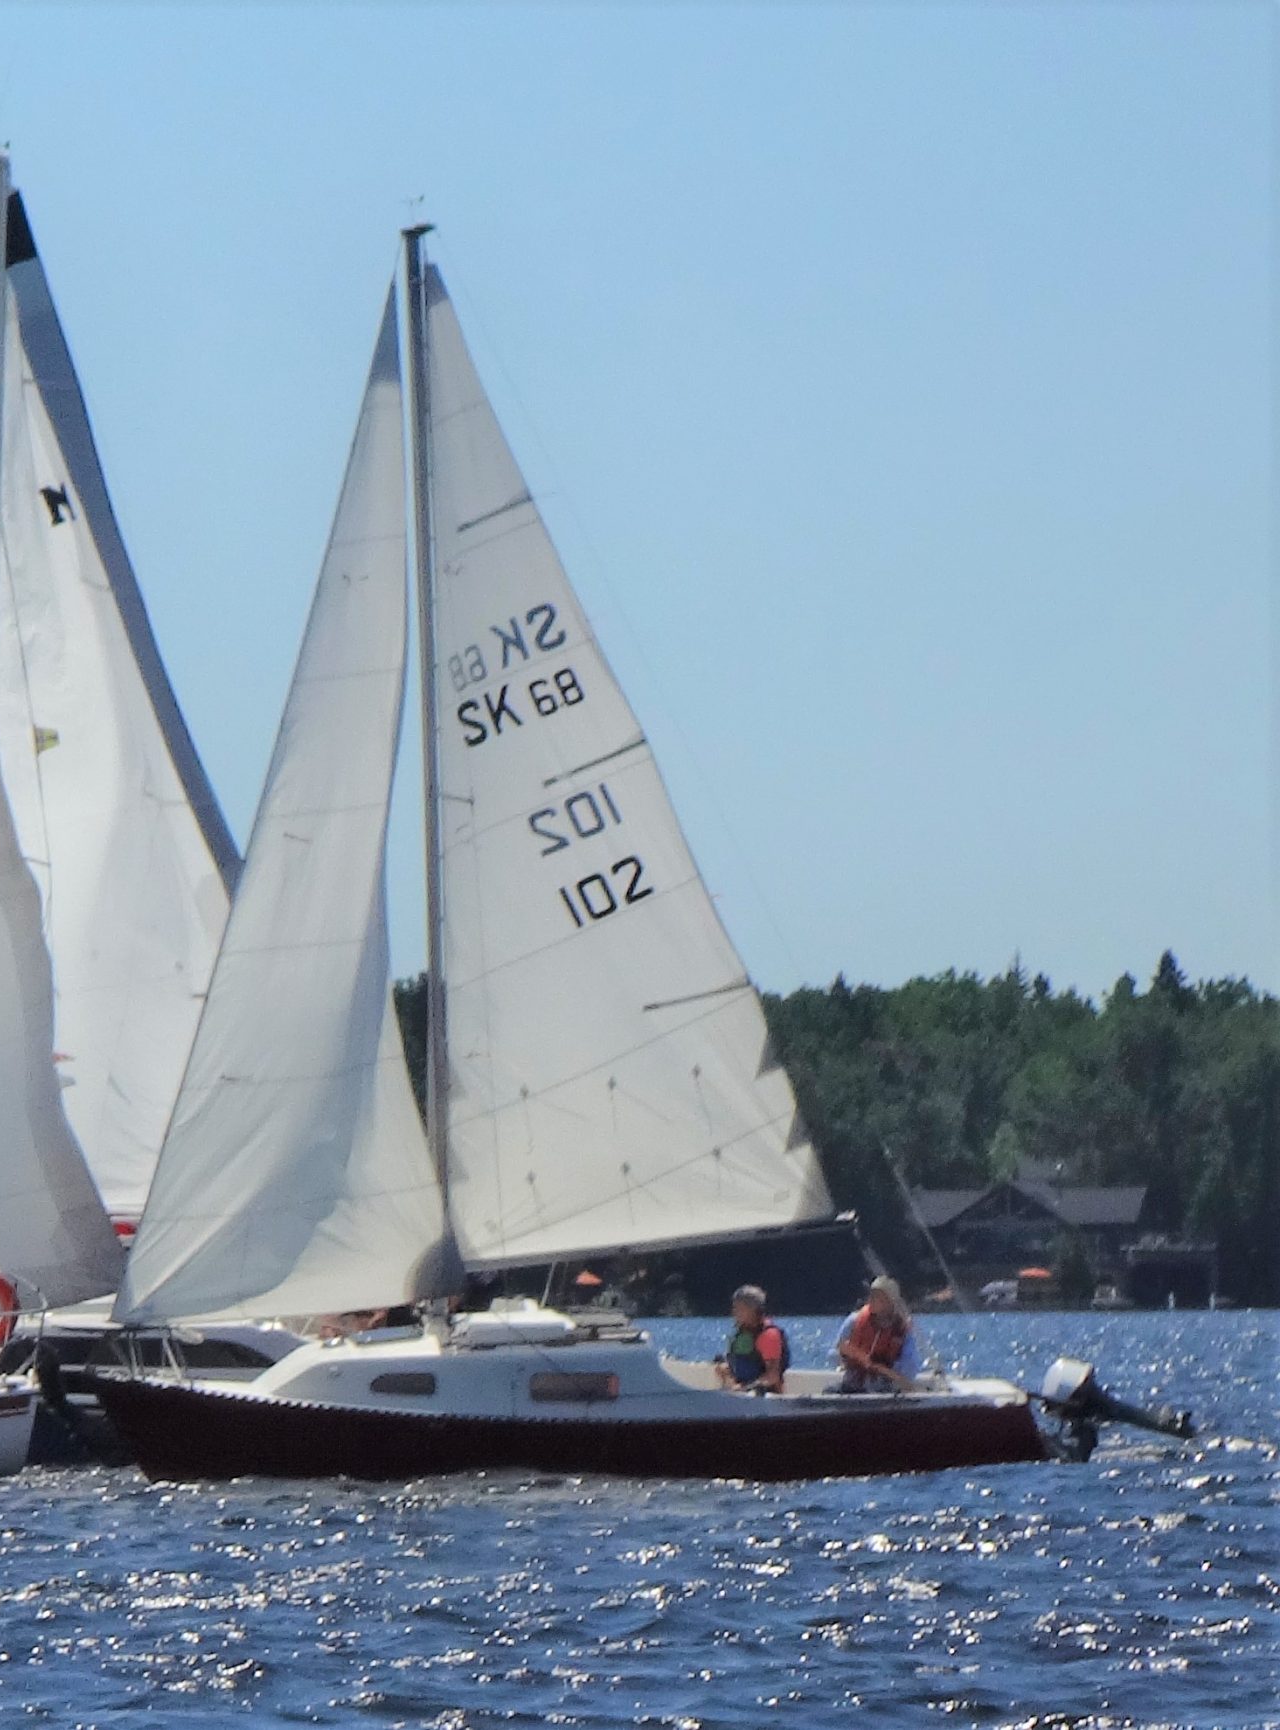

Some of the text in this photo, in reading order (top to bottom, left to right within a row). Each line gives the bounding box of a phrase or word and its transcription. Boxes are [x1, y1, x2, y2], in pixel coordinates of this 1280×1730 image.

[457, 667, 585, 747] SK 68
[559, 855, 654, 928] 102
